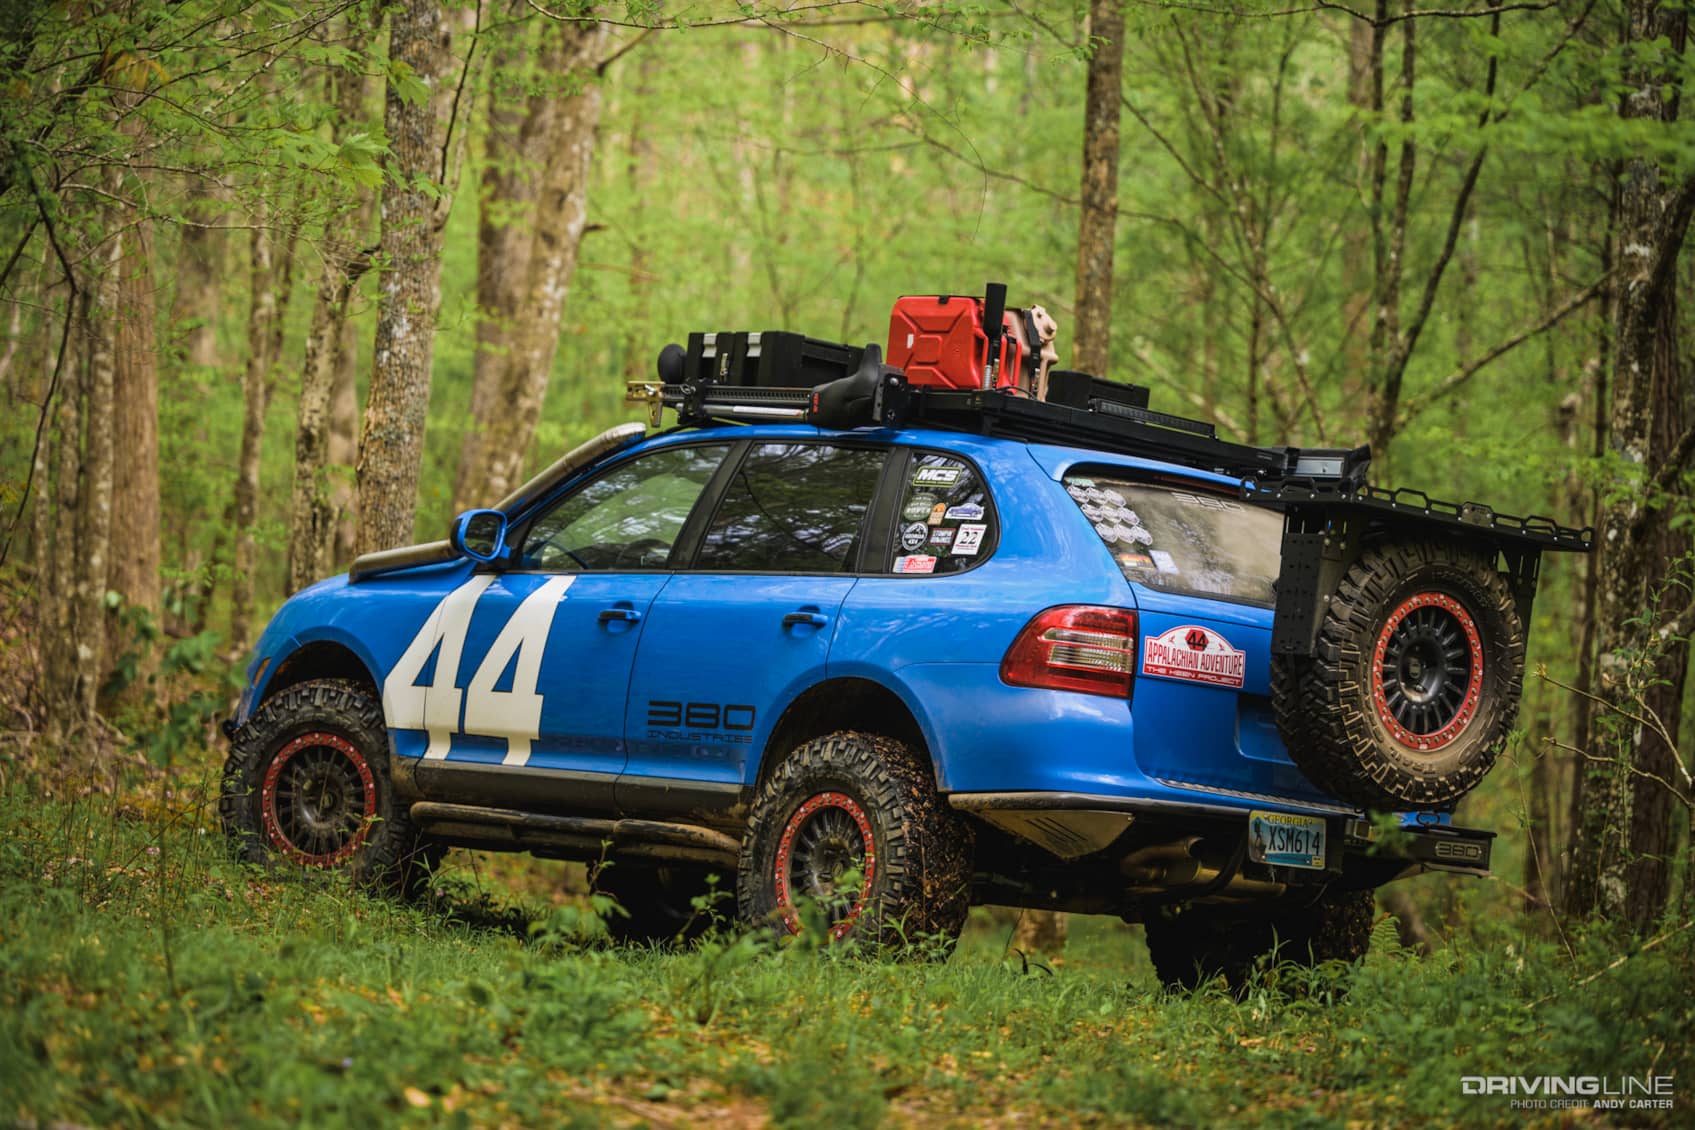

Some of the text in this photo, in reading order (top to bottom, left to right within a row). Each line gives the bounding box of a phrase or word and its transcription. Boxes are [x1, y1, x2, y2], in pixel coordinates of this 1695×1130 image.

[917, 469, 959, 481] MCS
[960, 531, 978, 545] 22
[1186, 631, 1206, 649] 44
[1148, 641, 1242, 676] APPALACHIAN ADVENTURE
[382, 575, 577, 767] 44
[1146, 666, 1166, 674] THE
[1197, 672, 1240, 685] PROJECT
[647, 700, 756, 731] 380
[647, 730, 753, 744] INDUSTRIES
[1267, 814, 1310, 828] GEORGIA
[1268, 825, 1320, 856] XSM614
